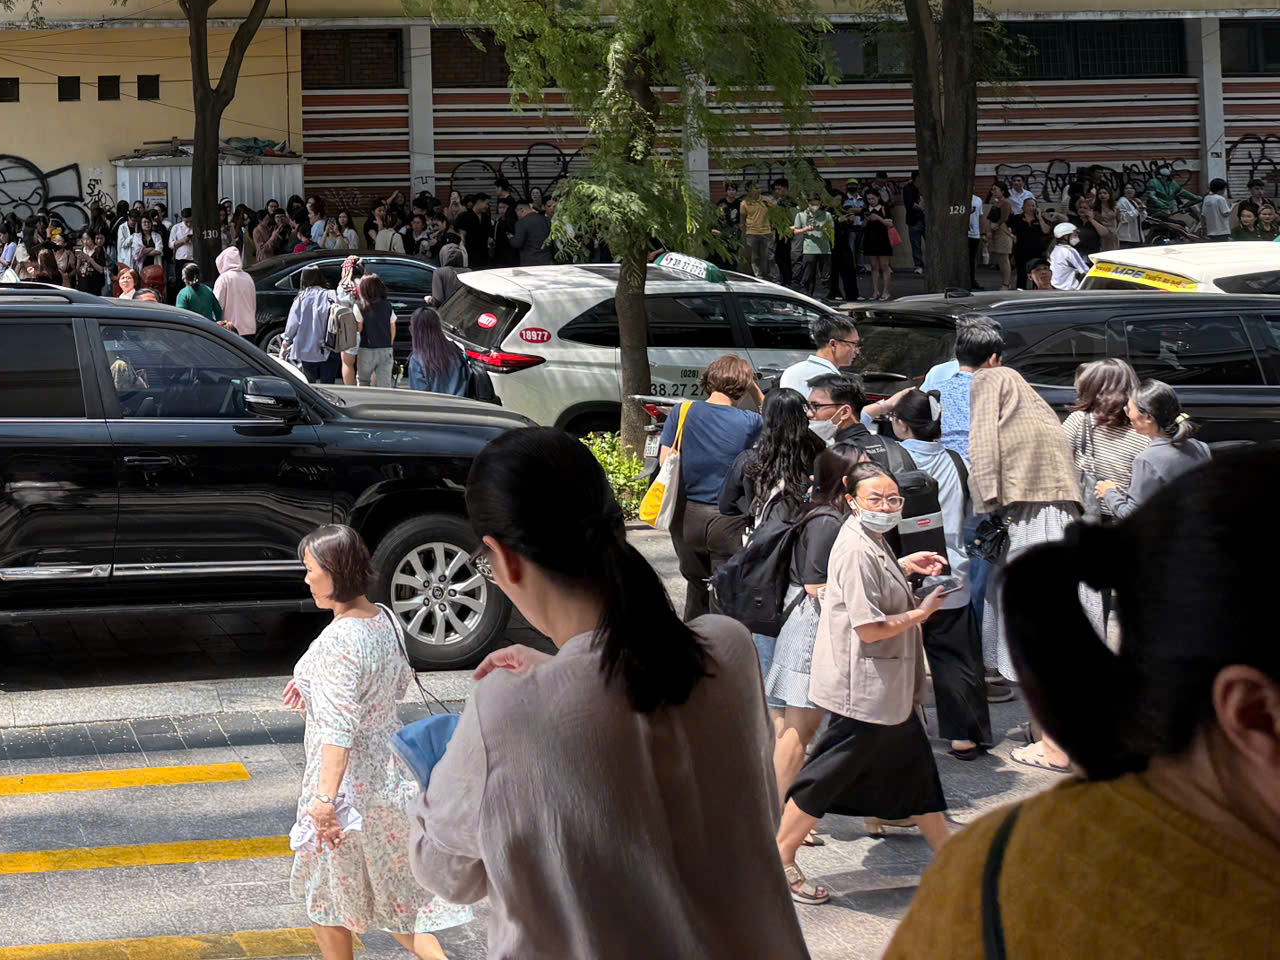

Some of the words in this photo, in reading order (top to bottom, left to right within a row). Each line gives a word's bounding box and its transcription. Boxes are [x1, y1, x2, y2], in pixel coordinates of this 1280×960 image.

[949, 205, 966, 215] 128
[202, 230, 218, 240] 130
[521, 330, 549, 341] 18977
[680, 369, 699, 379] (028)
